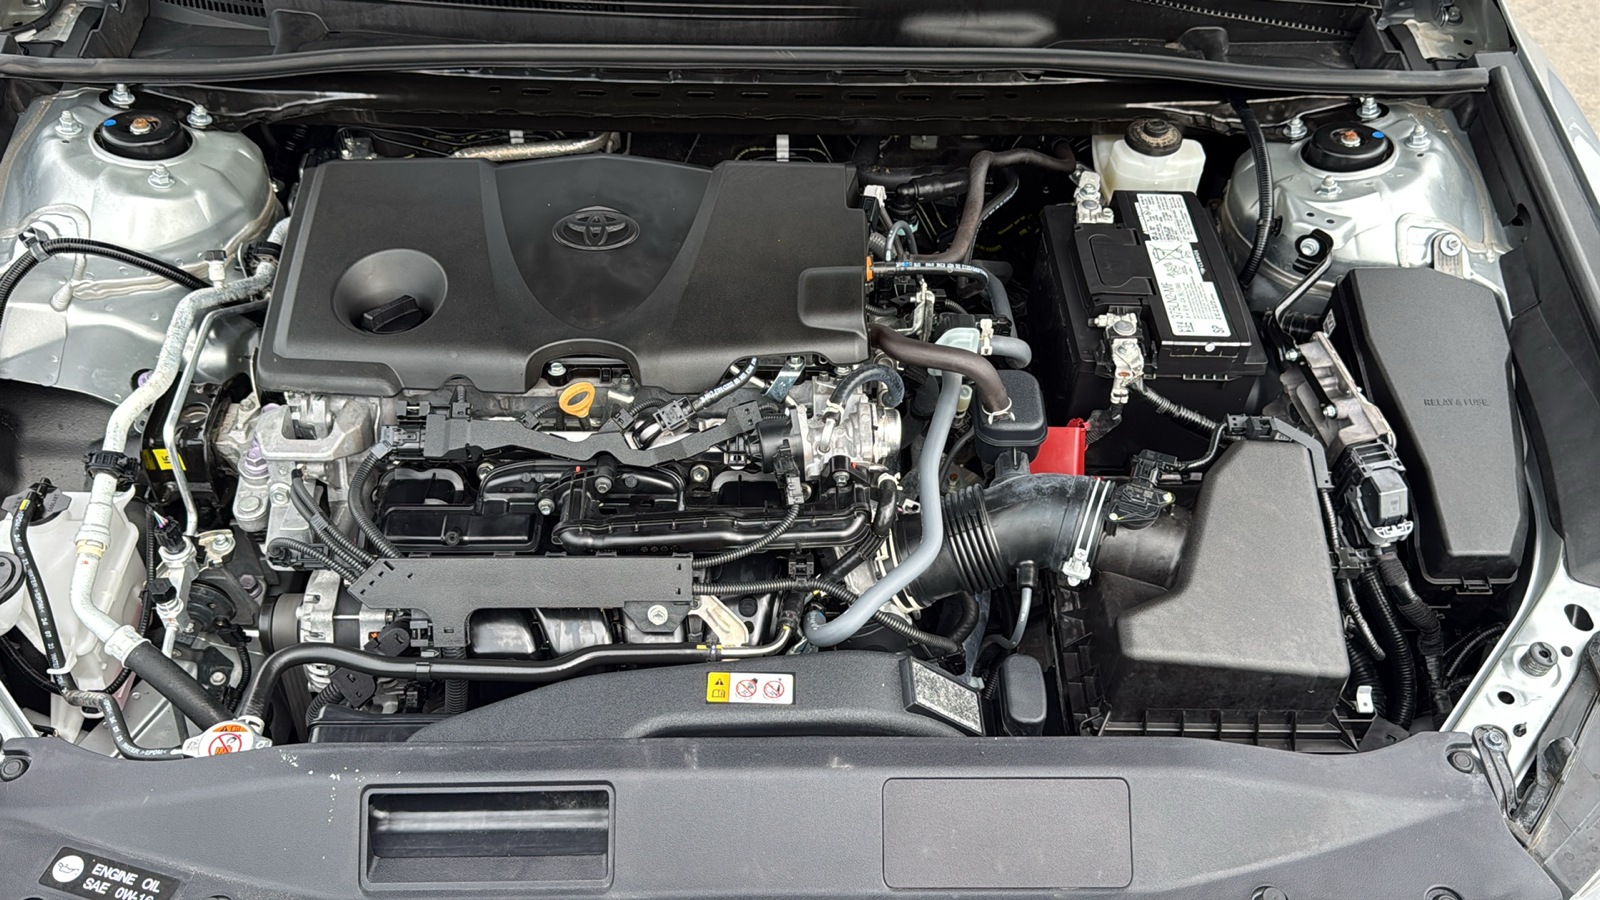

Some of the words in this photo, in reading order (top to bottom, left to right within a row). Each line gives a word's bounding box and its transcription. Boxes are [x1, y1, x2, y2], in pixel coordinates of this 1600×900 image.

[1424, 398, 1453, 406] RELAY
[27, 569, 38, 589] WATER
[121, 742, 140, 755] WATER
[82, 877, 111, 895] SAE
[91, 863, 138, 886] ENGINE
[141, 878, 161, 893] OIL
